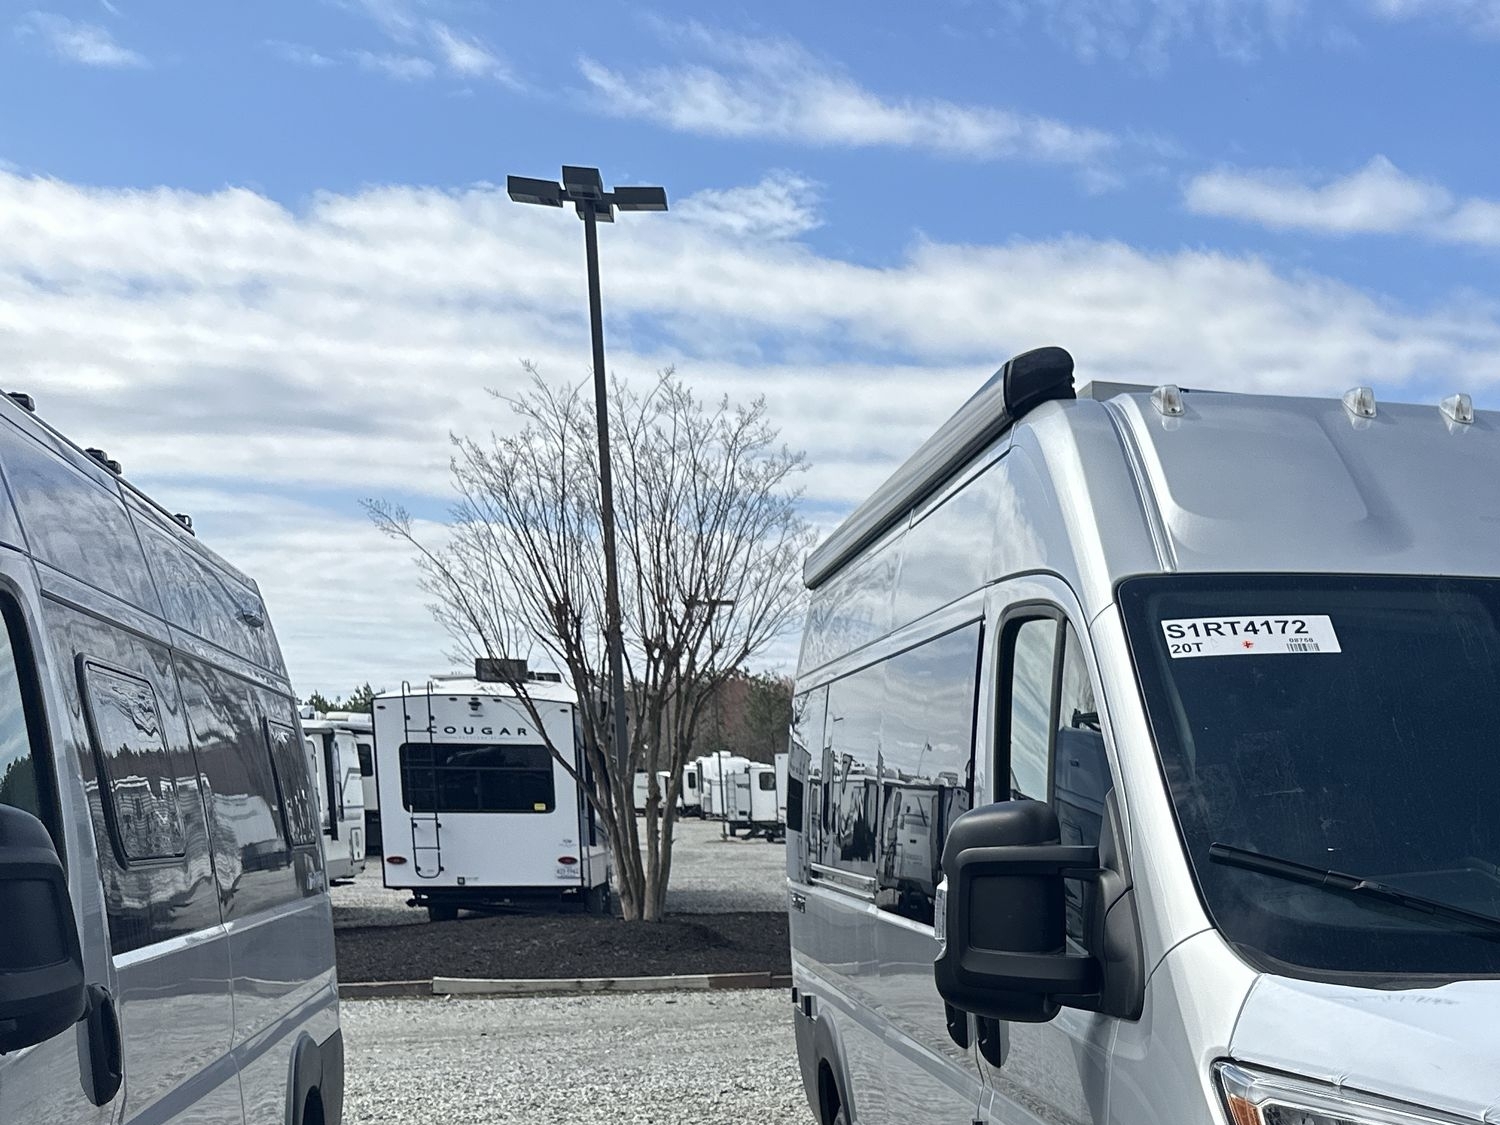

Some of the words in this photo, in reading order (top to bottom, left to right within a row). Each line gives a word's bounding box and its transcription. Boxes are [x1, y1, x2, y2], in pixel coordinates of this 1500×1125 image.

[1166, 619, 1309, 639] S1RT4172
[1170, 642, 1203, 654] 20T
[426, 726, 527, 736] COUGAR
